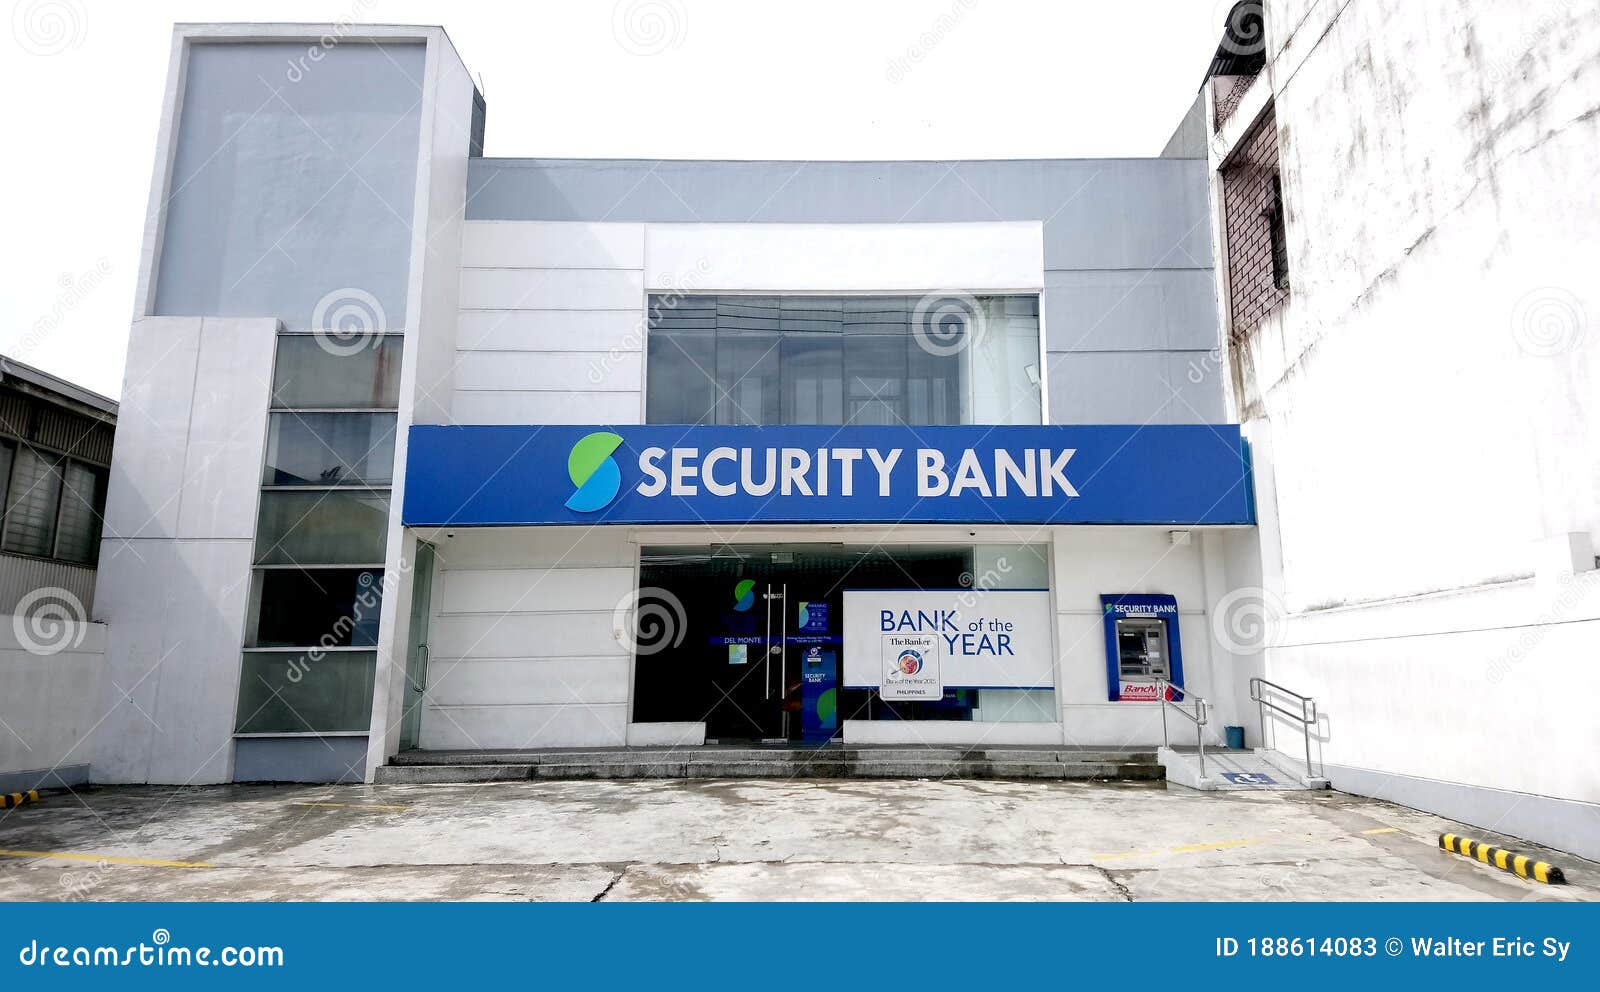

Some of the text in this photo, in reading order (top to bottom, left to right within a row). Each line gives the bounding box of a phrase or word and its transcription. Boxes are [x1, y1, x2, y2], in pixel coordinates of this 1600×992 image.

[636, 446, 1080, 498] SECURITY BANK
[1115, 604, 1177, 613] SECURITY BANK
[880, 609, 1013, 632] BANK of the
[889, 638, 931, 646] The Banker
[942, 633, 1015, 656] YEAR
